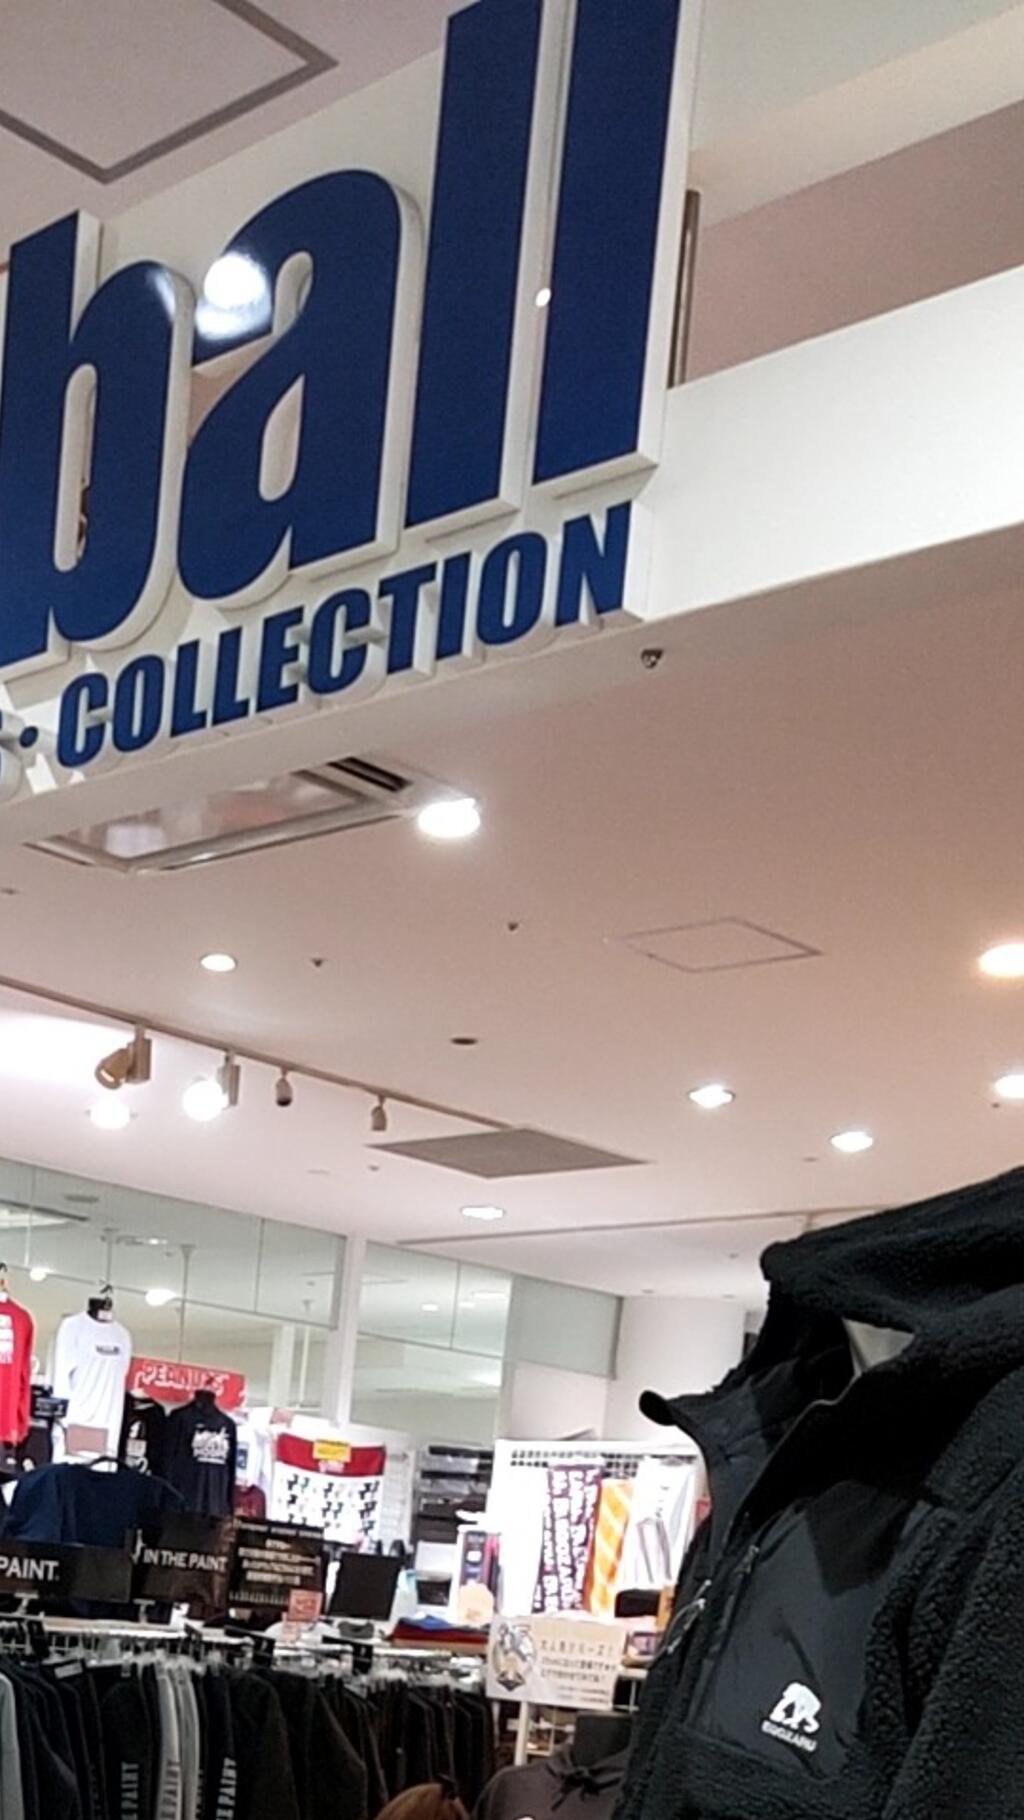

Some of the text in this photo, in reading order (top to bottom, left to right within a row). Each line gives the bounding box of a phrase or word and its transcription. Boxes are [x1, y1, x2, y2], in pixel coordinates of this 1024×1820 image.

[143, 1549, 228, 1572] IN THE PAINT
[218, 1757, 236, 1807] PAINT
